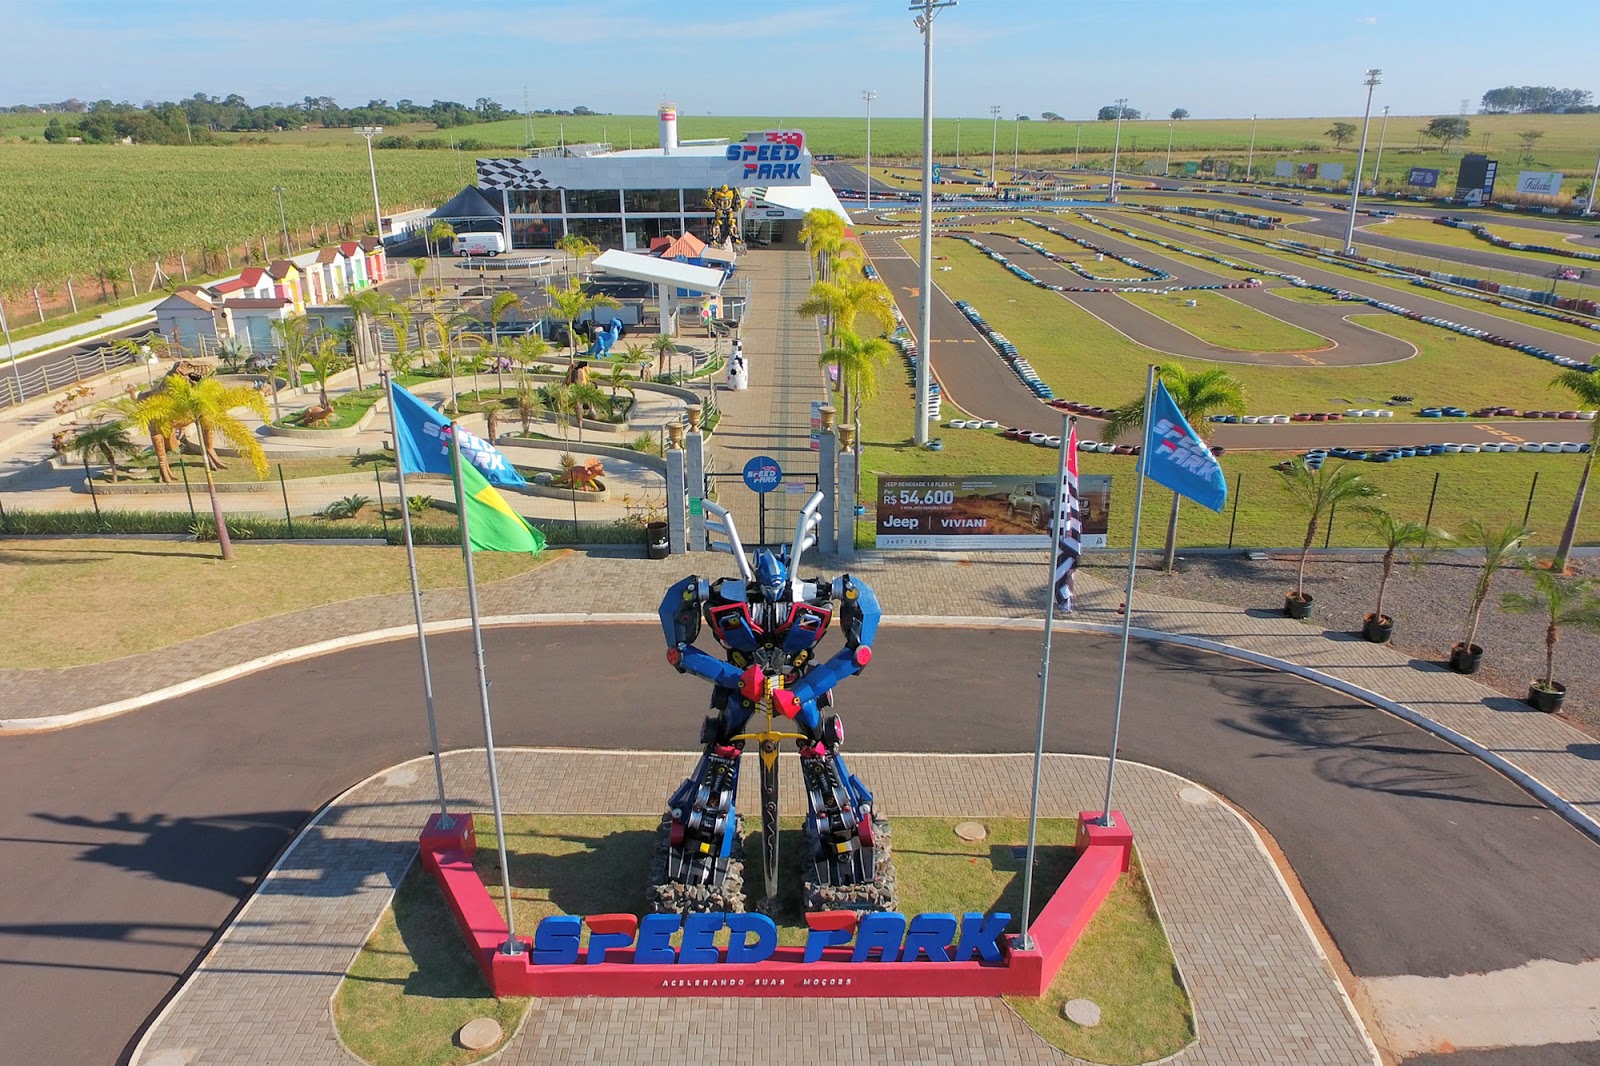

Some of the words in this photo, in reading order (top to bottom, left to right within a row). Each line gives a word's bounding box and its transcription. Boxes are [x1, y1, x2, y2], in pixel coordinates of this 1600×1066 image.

[727, 144, 800, 161] SPEED
[743, 163, 802, 180] PARK
[1154, 438, 1221, 482] PARK
[747, 470, 776, 478] SPEED
[753, 476, 777, 484] PARK
[883, 494, 897, 505] R$
[883, 515, 919, 530] Jeep
[940, 518, 987, 528] VIVIANI
[532, 912, 778, 965] SPEED
[802, 909, 1012, 963] PARK
[662, 979, 745, 987] ACELERANDO
[754, 978, 785, 986] SUAS
